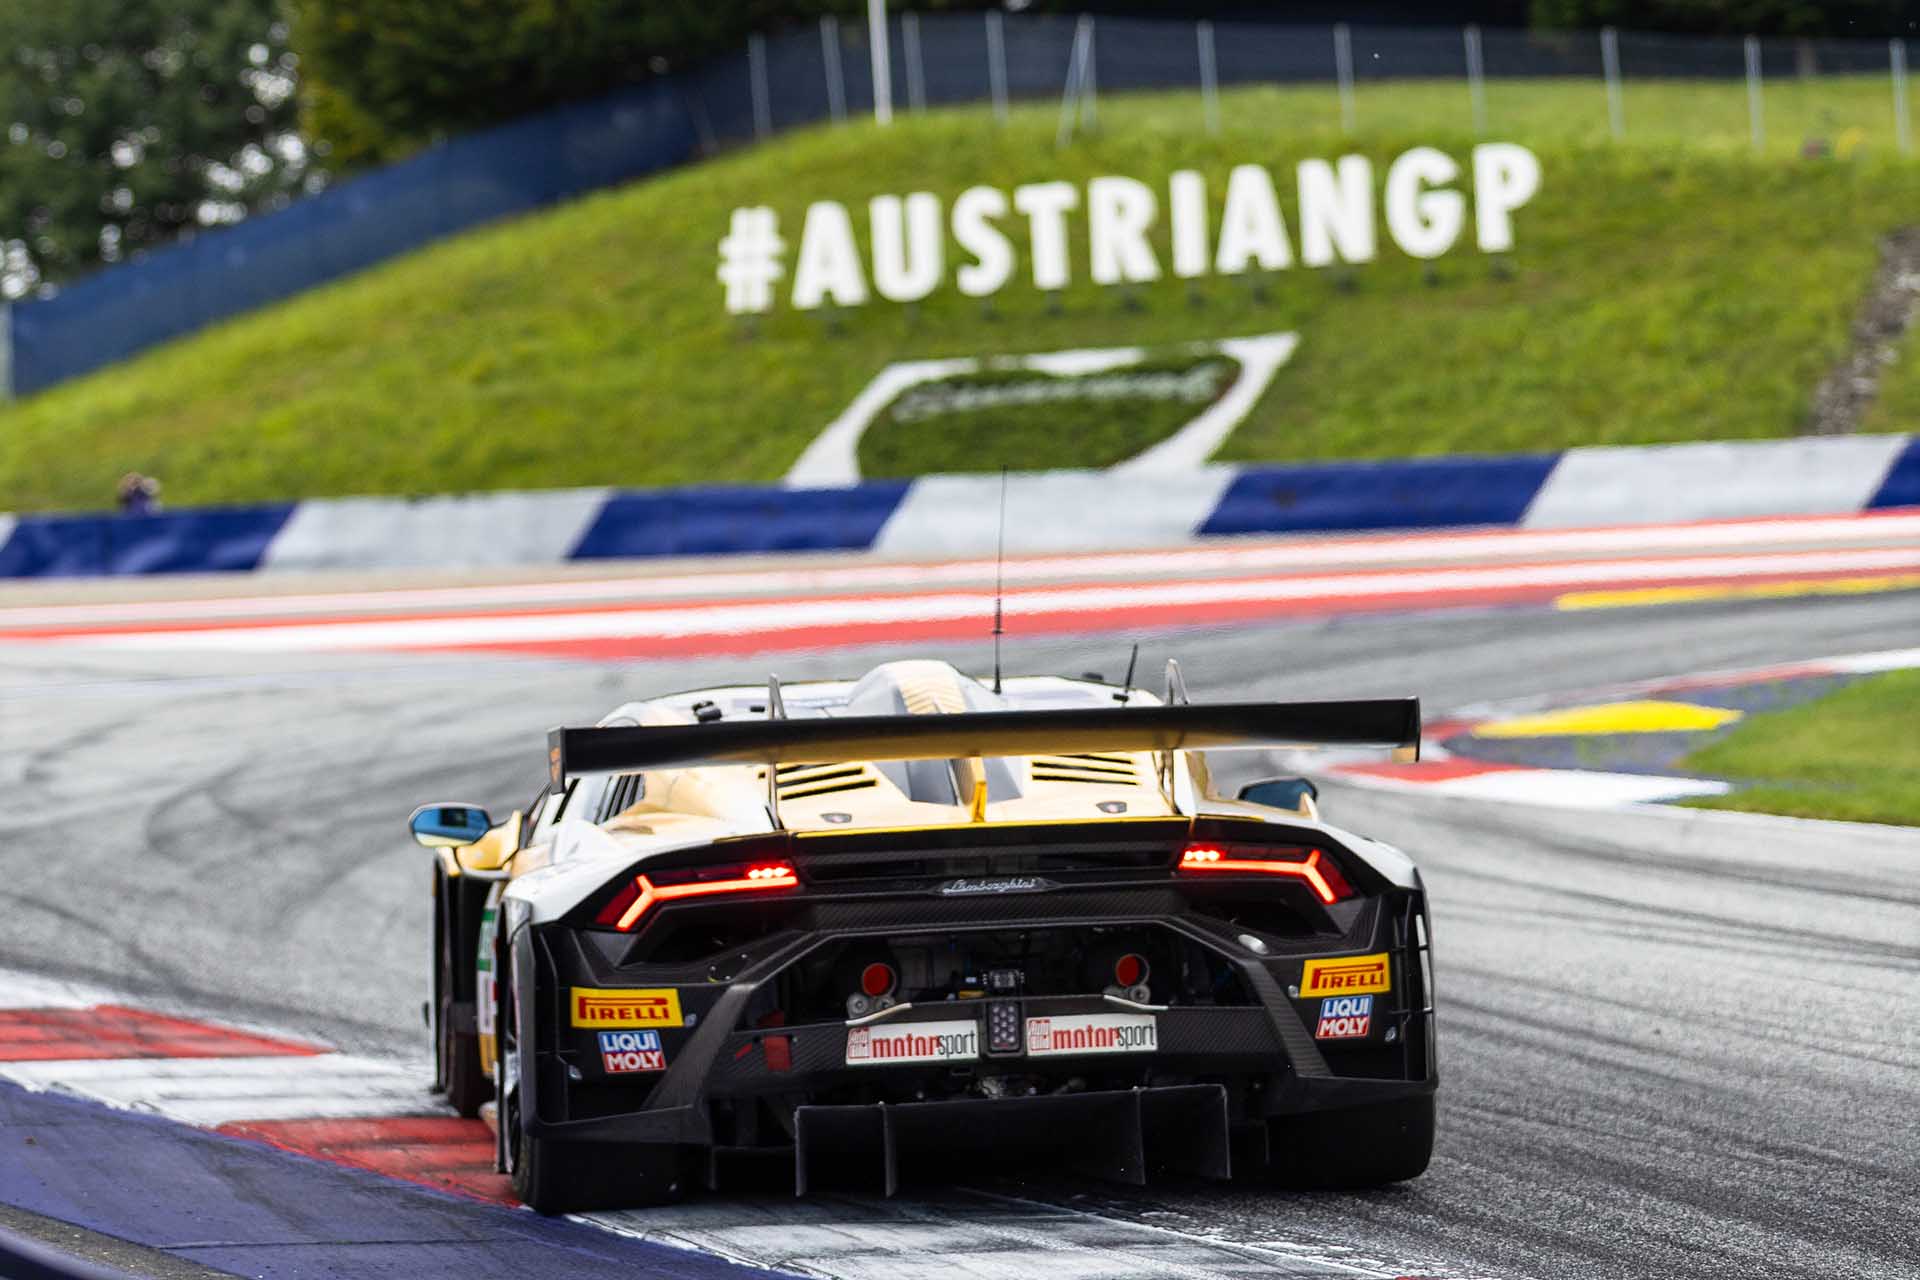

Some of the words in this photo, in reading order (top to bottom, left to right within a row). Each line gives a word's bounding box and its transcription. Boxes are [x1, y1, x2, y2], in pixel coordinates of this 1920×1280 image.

[717, 142, 1541, 315] #AUSTRIANGP
[1310, 962, 1385, 990] PIRELLI
[577, 995, 670, 1020] PIRELLI
[1322, 997, 1370, 1018] LIQUI
[1052, 1023, 1155, 1050] motorsport
[1319, 1017, 1368, 1036] MOLY
[601, 1032, 658, 1052] LIQUI
[871, 1029, 977, 1059] motorsport
[606, 1051, 662, 1071] MOLY
